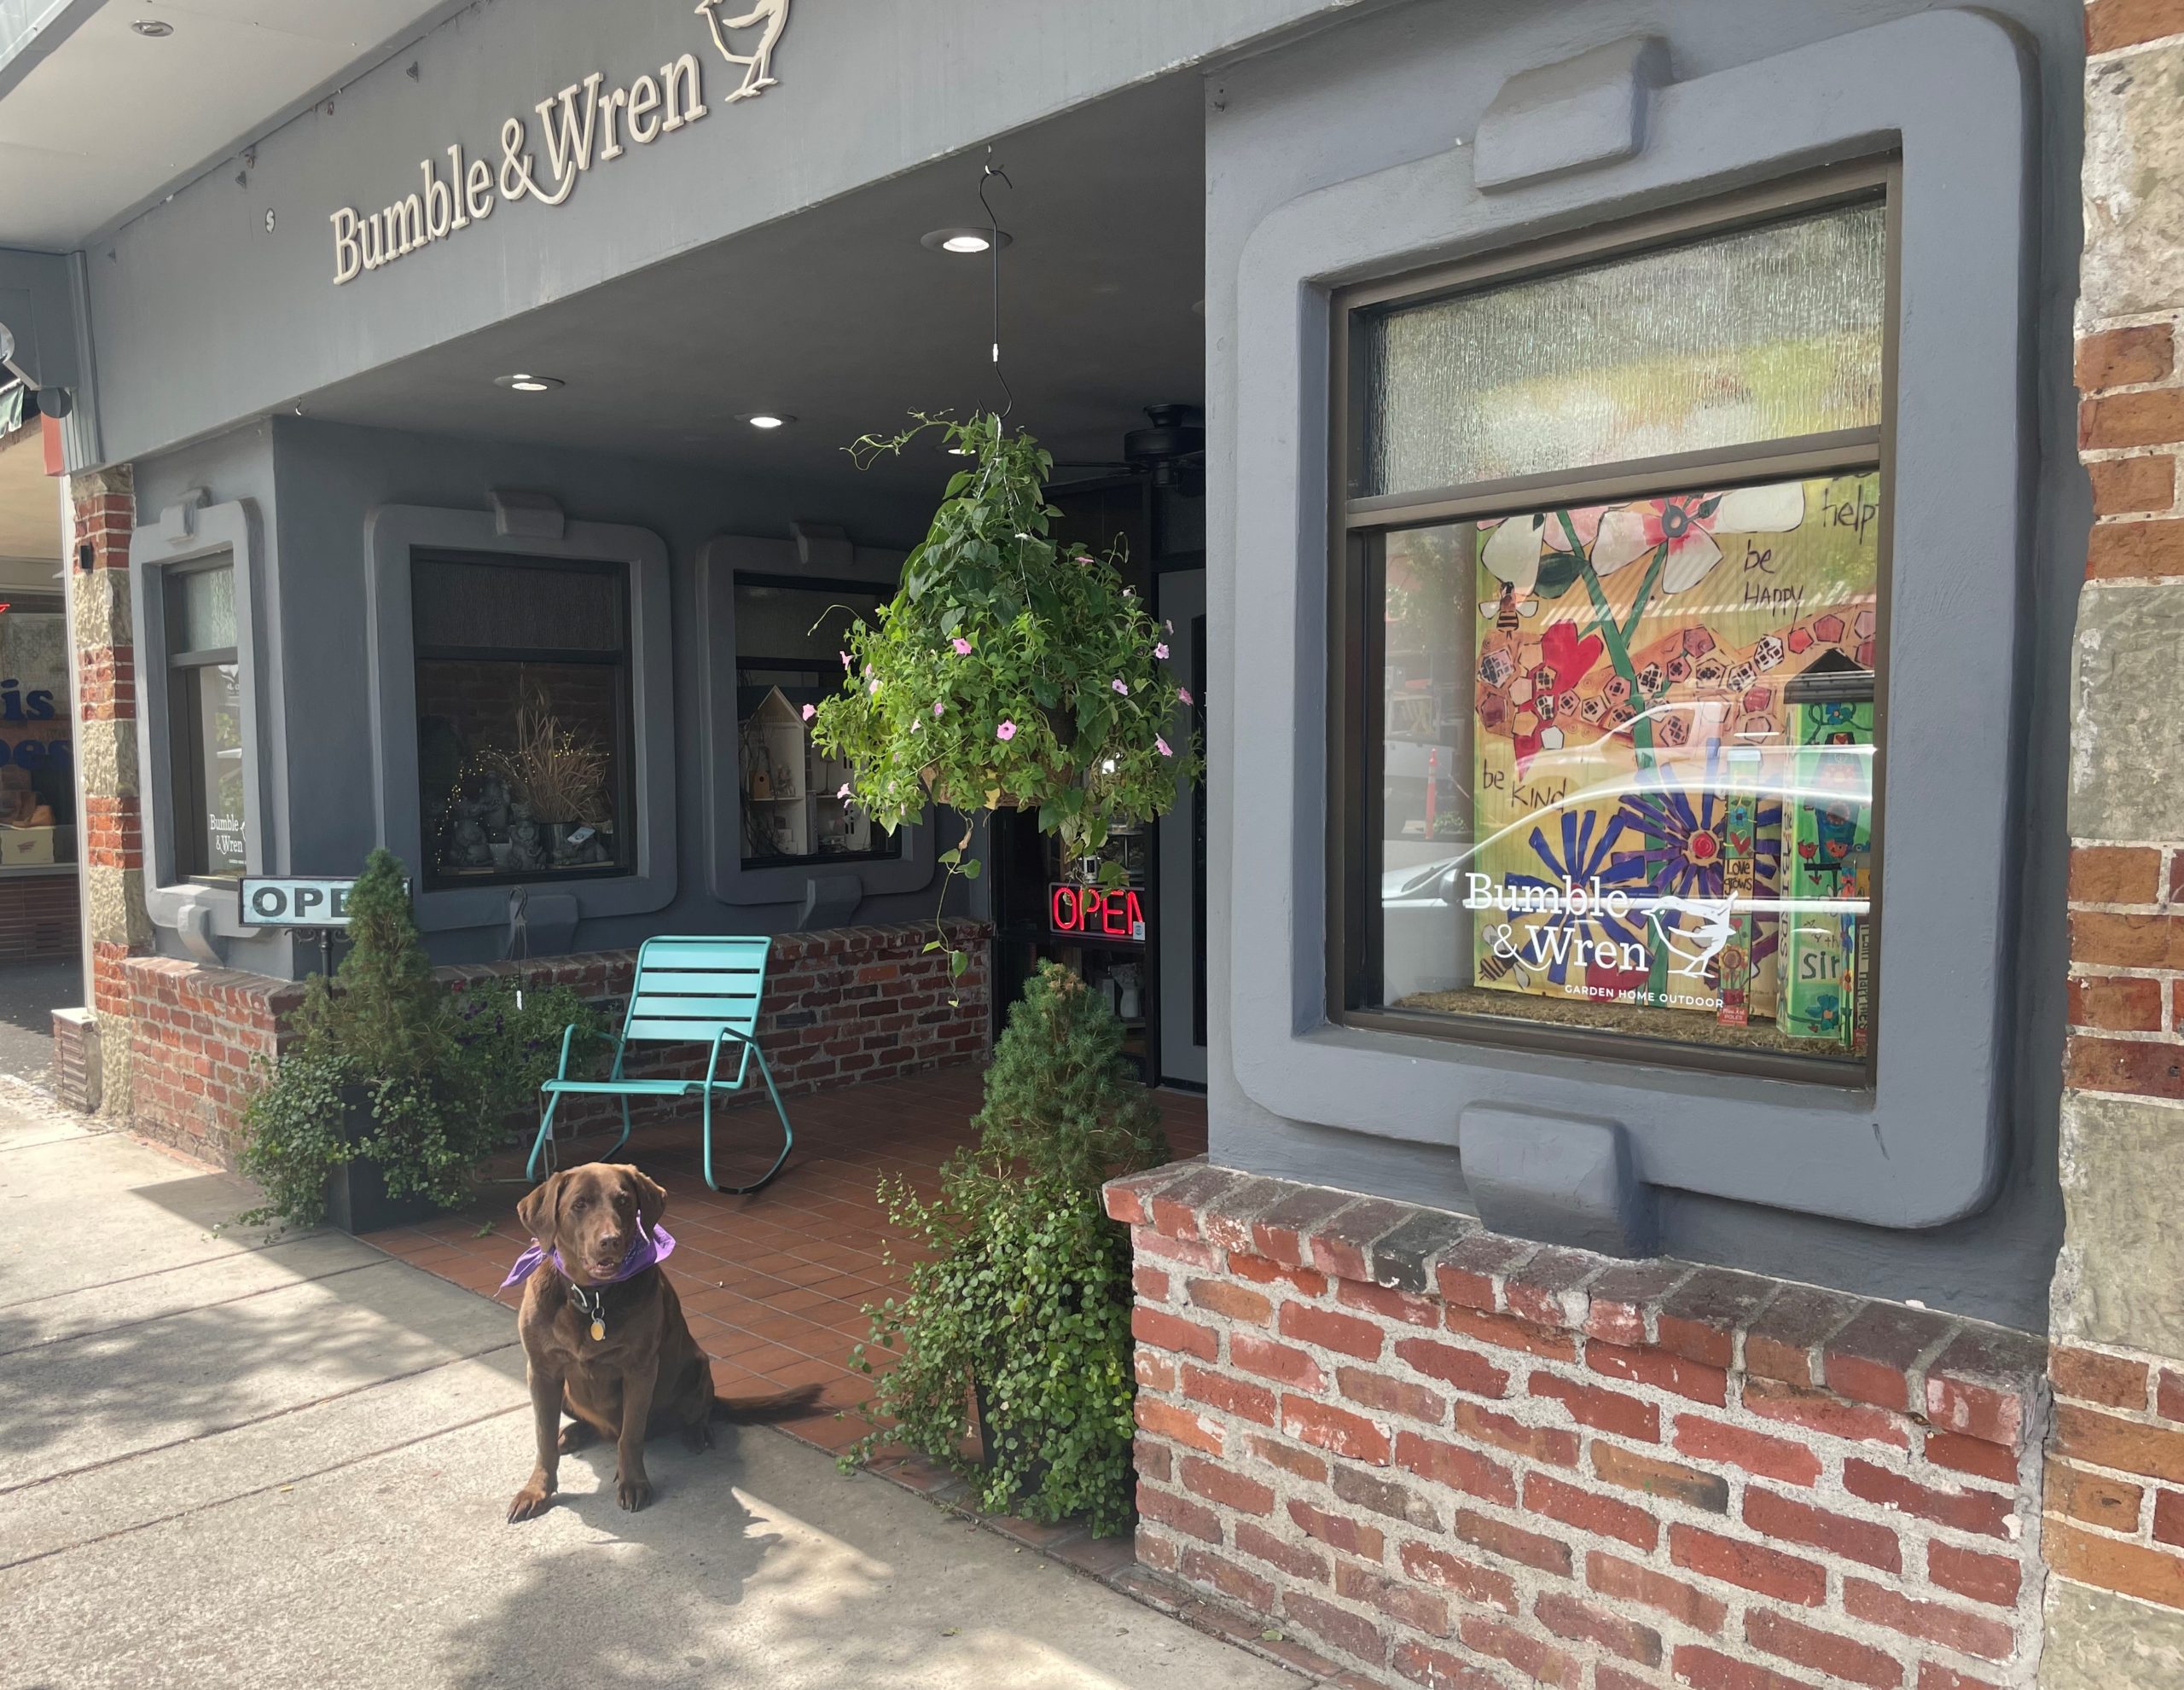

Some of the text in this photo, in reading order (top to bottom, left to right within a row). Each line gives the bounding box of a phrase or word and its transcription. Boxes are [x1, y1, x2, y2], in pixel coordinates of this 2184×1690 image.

[330, 53, 707, 284] Bumble & Wren
[1822, 485, 1879, 545] help
[1744, 539, 1774, 574] be
[1483, 758, 1504, 790] be
[210, 814, 239, 832] Bumble
[216, 834, 243, 855] & Wren
[253, 886, 350, 918] OPE
[1465, 872, 1629, 919] Bumble
[1493, 924, 1649, 972] & Wren
[1565, 984, 1724, 1008] GARDEN HOME OUTDOOR
